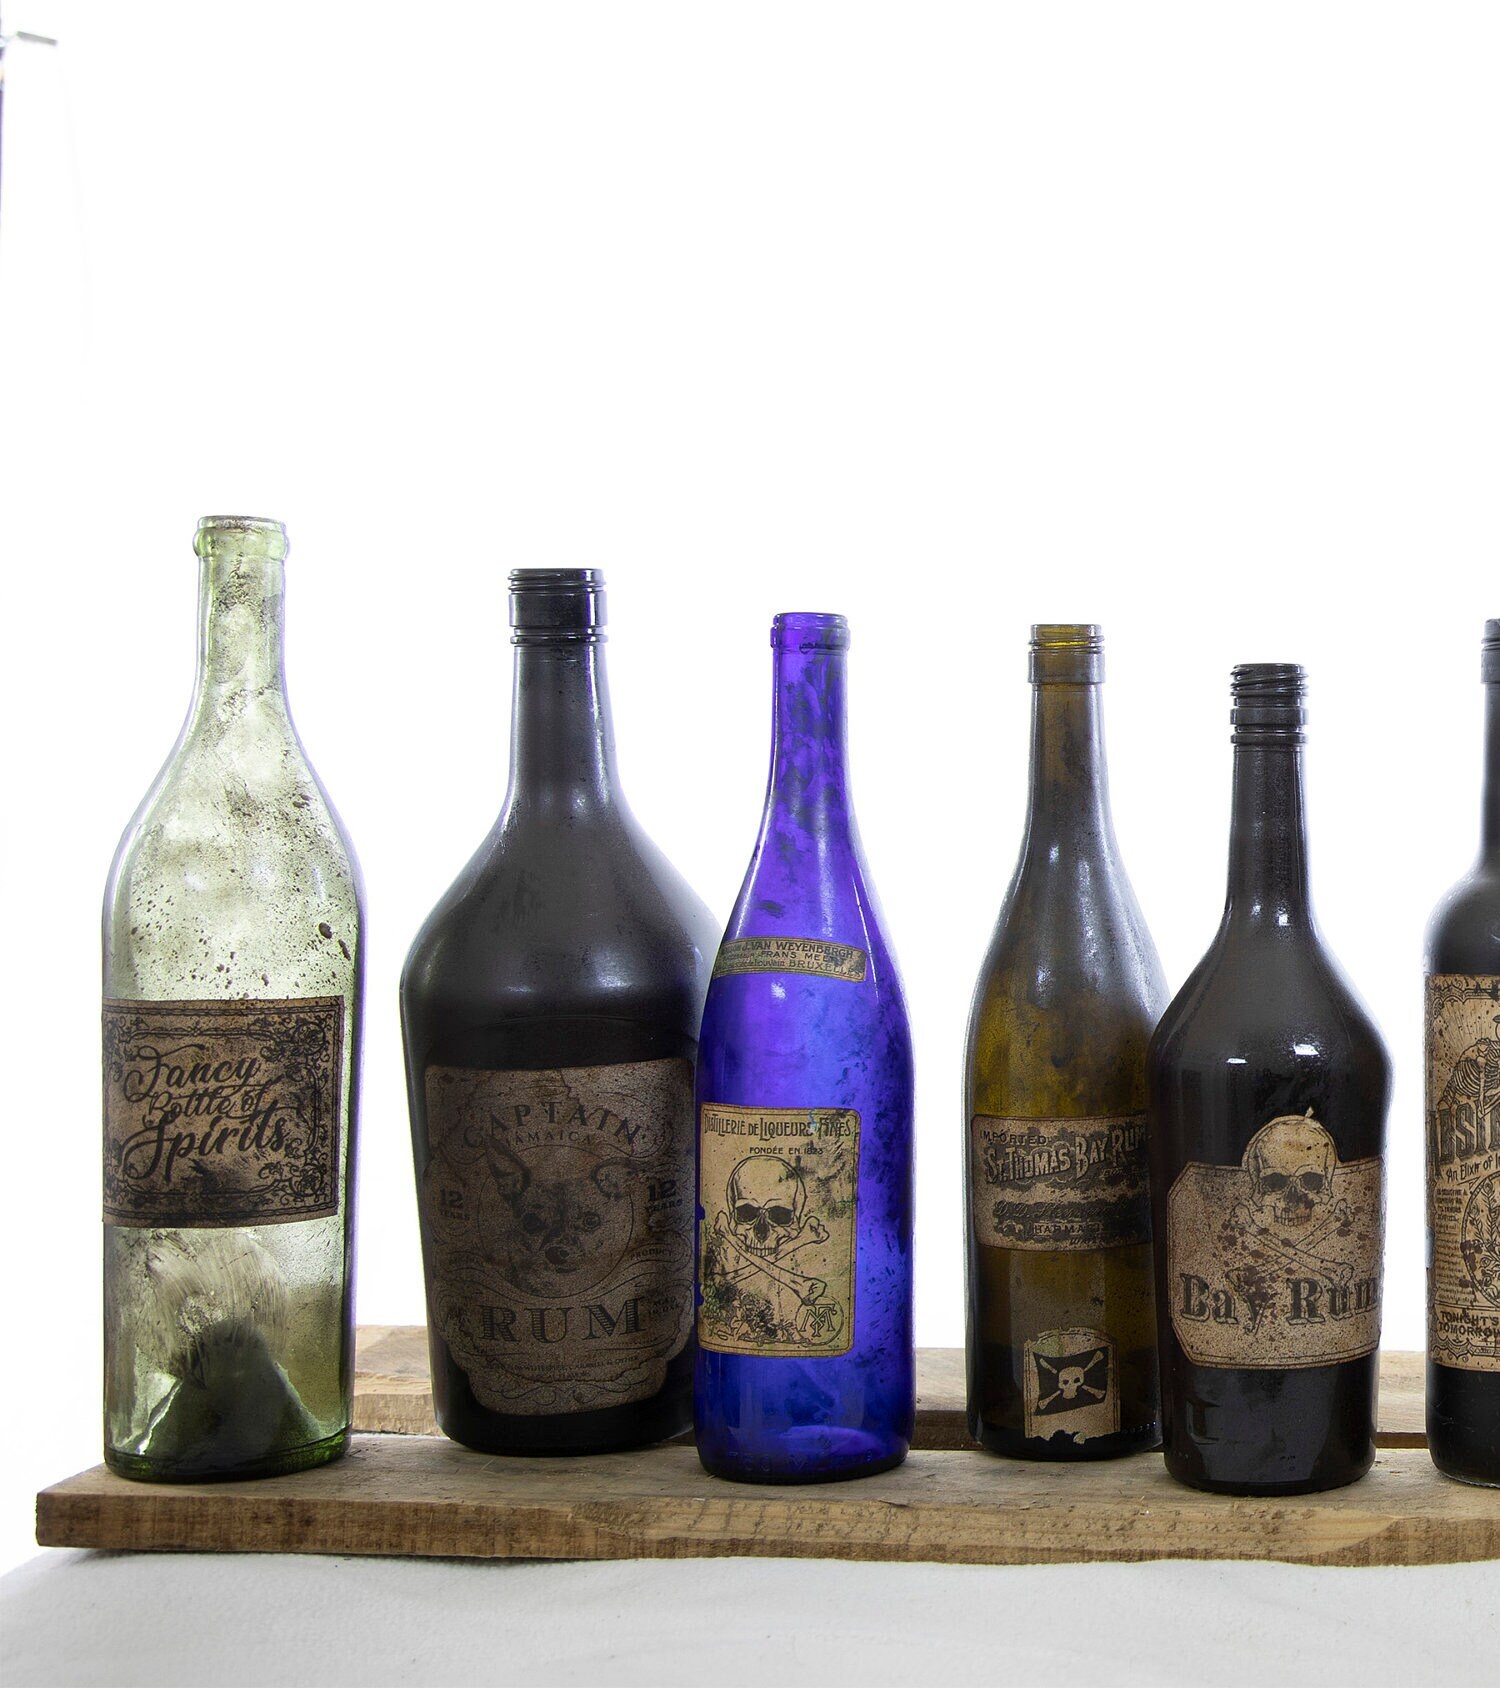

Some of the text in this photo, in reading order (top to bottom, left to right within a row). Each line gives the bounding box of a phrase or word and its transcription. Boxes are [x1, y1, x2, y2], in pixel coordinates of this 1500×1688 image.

[751, 941, 771, 950] VAN
[776, 941, 854, 959] WEYENBERGH
[762, 951, 797, 959] FRANS
[789, 960, 862, 978] BRUXELLES
[124, 1043, 259, 1102] Fancy
[149, 1086, 231, 1117] Bottle
[464, 1101, 642, 1149] CAPTAIN
[704, 1113, 746, 1137] DISTILLERIE
[759, 1117, 814, 1141] LIQUEURS
[818, 1117, 851, 1138] FINES
[981, 1129, 1048, 1146] IMPORTED
[119, 1100, 288, 1183] Spirits
[750, 1145, 783, 1155] FONDÉE
[1004, 1147, 1071, 1180] THOMAS
[1075, 1136, 1107, 1179] BAY
[1446, 1168, 1457, 1183] An
[1460, 1161, 1480, 1180] Elixir
[1483, 1155, 1494, 1171] of
[1180, 1272, 1378, 1335] Bay Rum
[478, 1296, 646, 1344] RUM
[1440, 1311, 1499, 1327] TONIGHT'S
